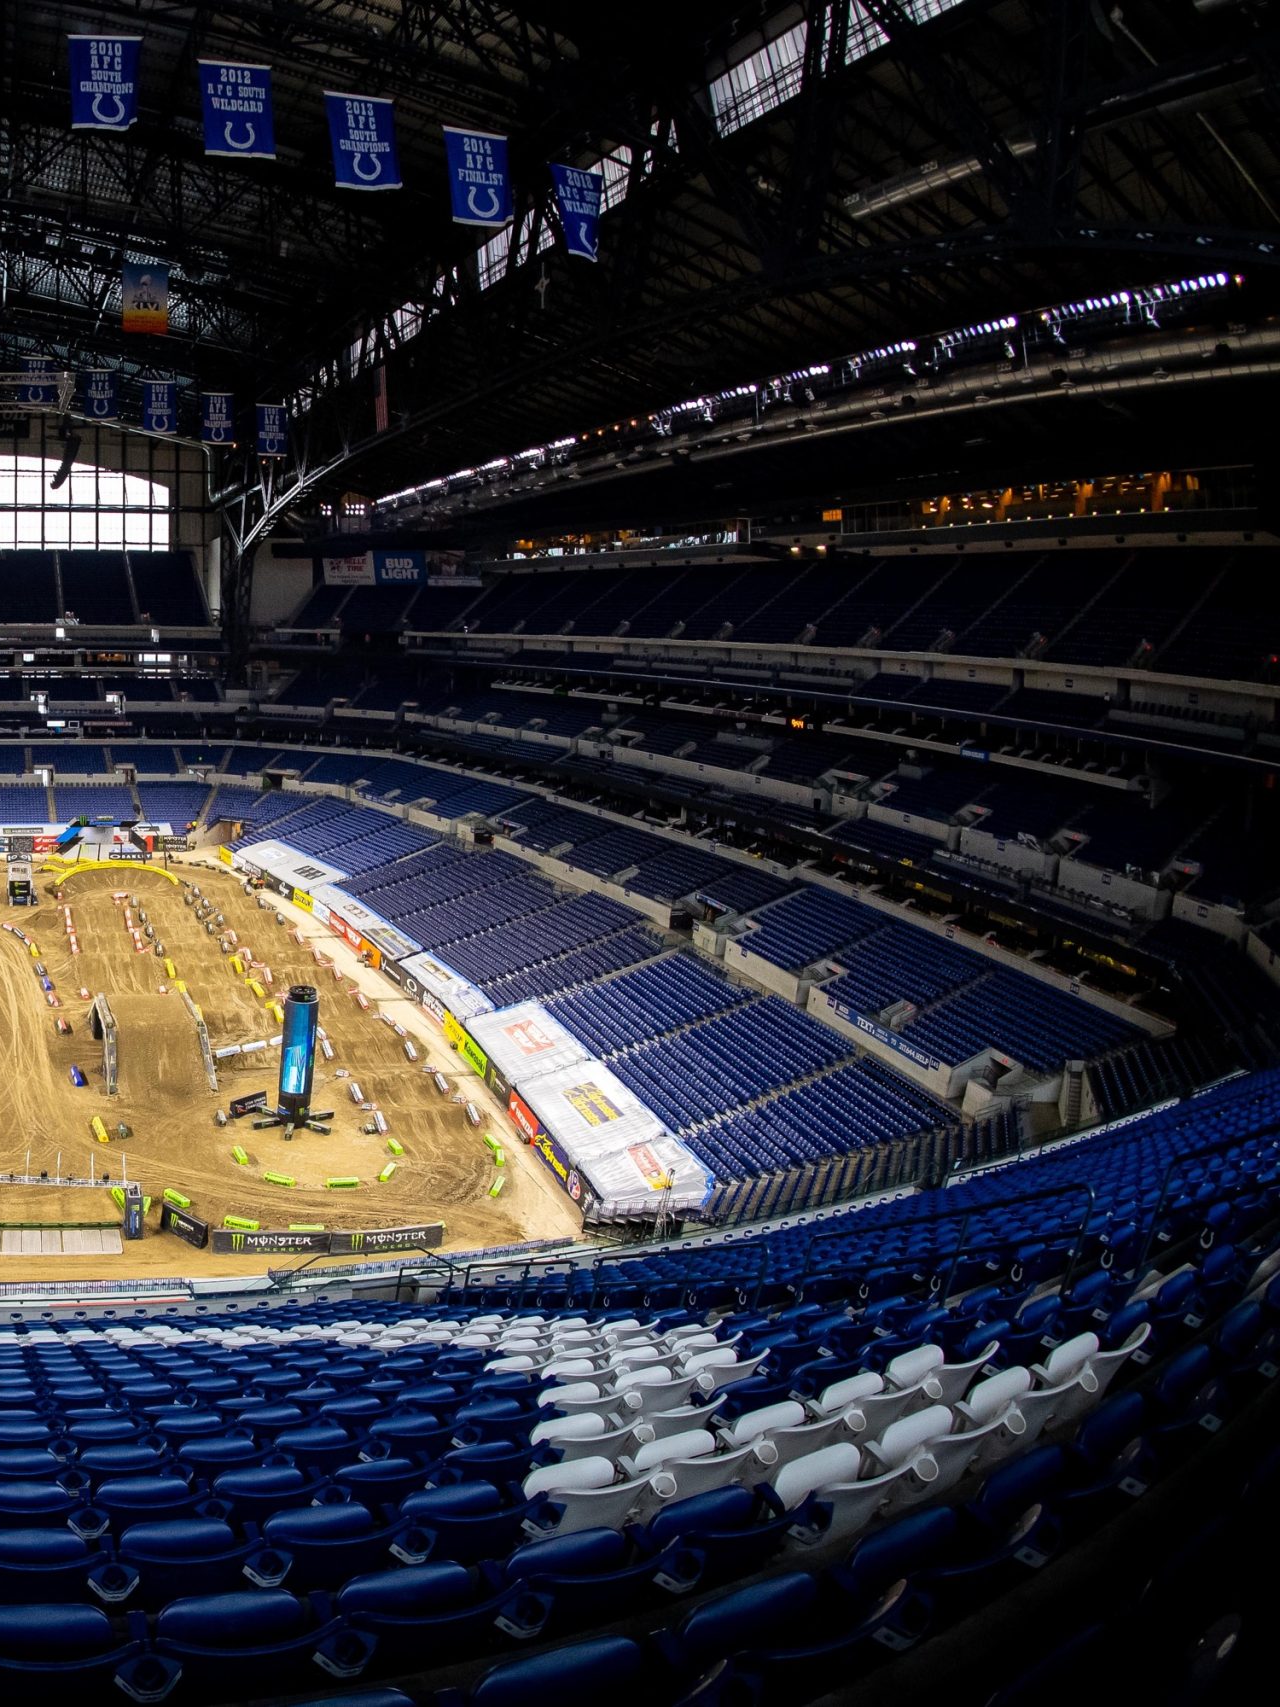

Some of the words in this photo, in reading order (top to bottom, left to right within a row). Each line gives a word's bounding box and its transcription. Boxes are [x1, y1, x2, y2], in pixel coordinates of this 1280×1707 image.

[90, 42, 122, 56] 2010
[91, 56, 122, 70] AFC
[91, 70, 122, 82] SOUTH
[220, 69, 251, 84] 2012
[80, 81, 133, 94] CHAMPIONS
[207, 83, 232, 96] AFC
[238, 87, 265, 99] SOUTH
[211, 97, 263, 113] WILDCARD
[345, 101, 374, 116] 2013
[348, 115, 376, 130] AFC
[349, 129, 377, 141] SOUTH
[340, 139, 390, 152] CHAMPIONS
[464, 137, 492, 155] 2014
[467, 154, 494, 171] AFC
[458, 168, 503, 186] FINALIST
[567, 169, 593, 189] 2018
[559, 184, 580, 200] AFC
[385, 558, 413, 568] BUD
[381, 569, 419, 580] LIGHT
[464, 1040, 485, 1073] Kawasaki
[516, 1108, 534, 1139] HONDA
[247, 1236, 312, 1246] MONSTER
[366, 1231, 427, 1245] MONSTER
[374, 1242, 418, 1250] ENERGY
